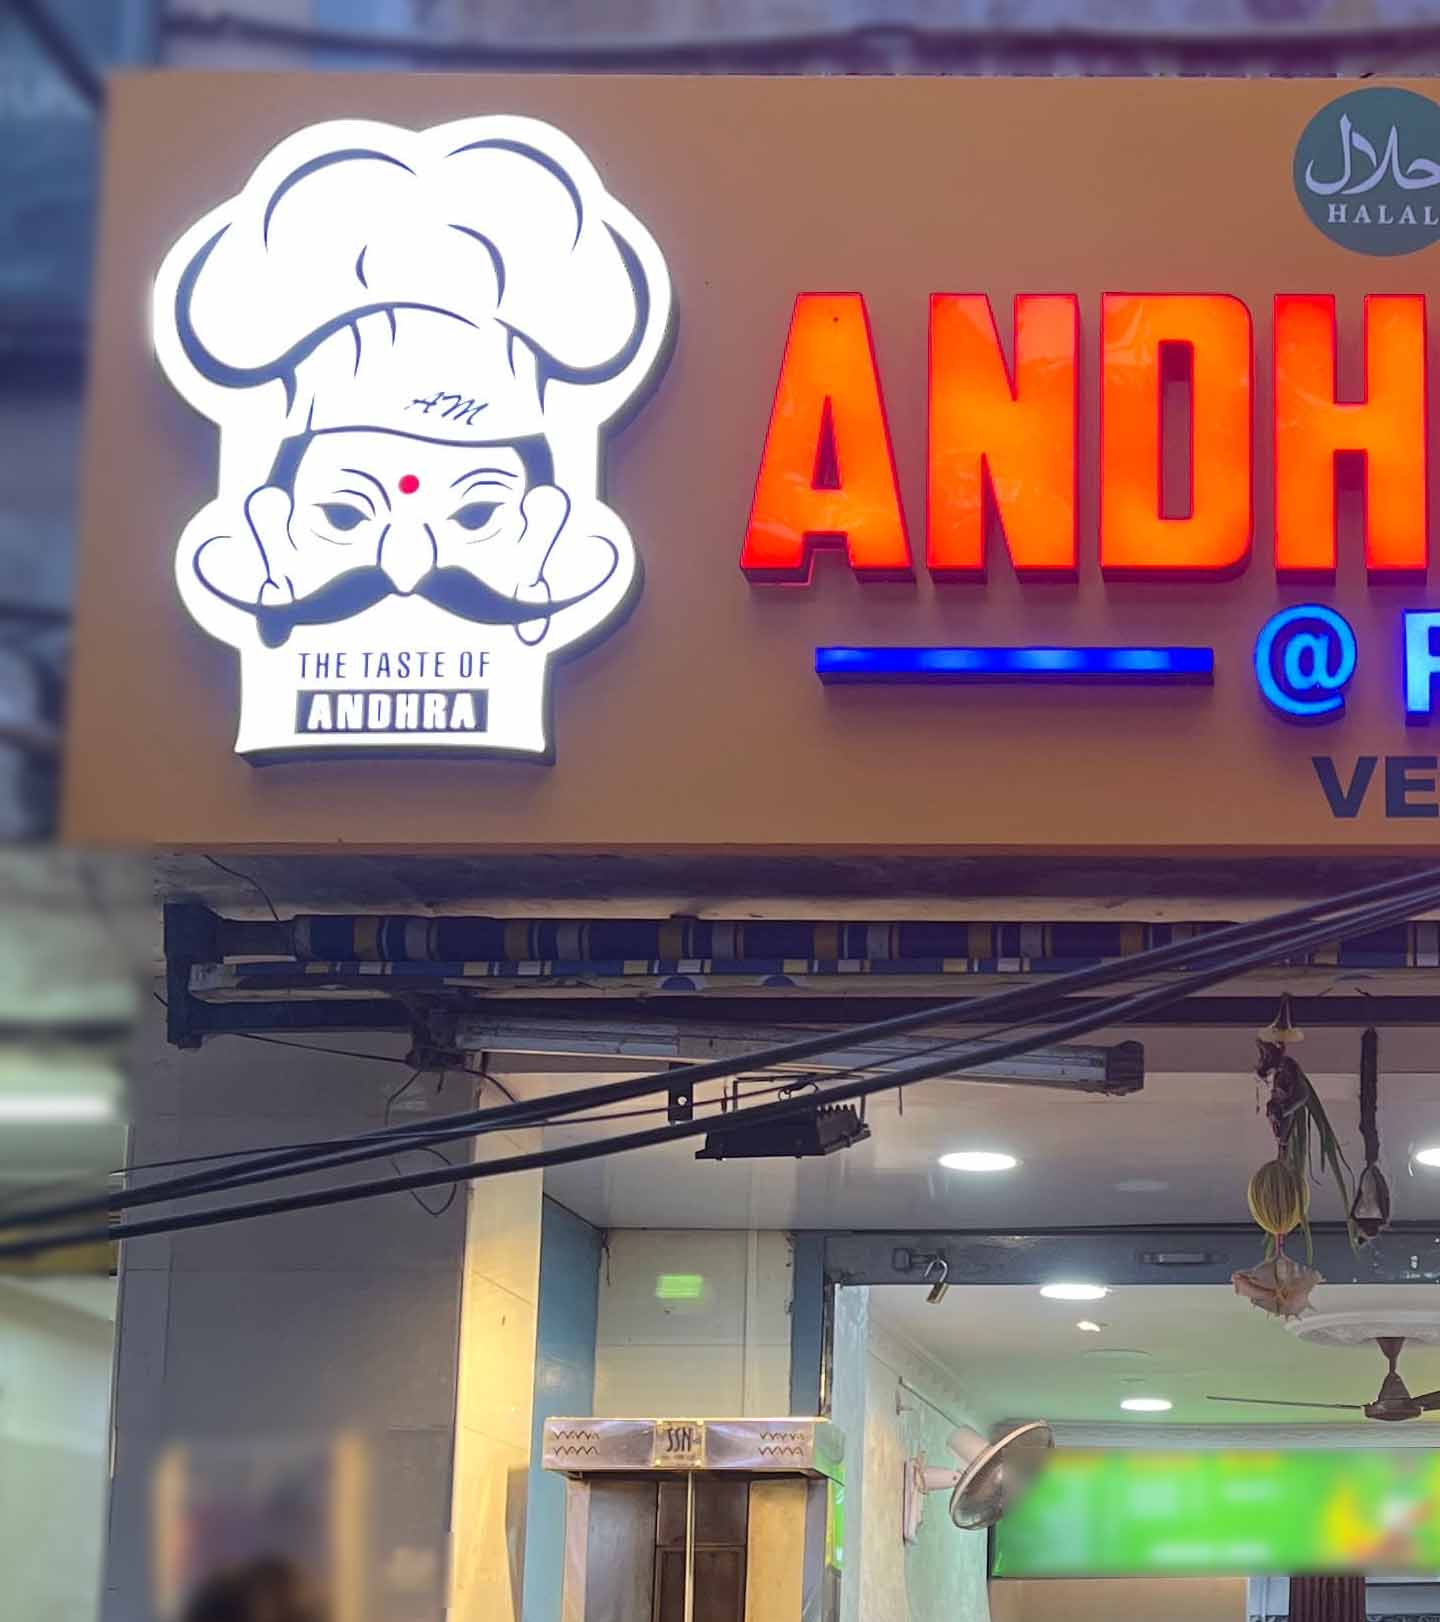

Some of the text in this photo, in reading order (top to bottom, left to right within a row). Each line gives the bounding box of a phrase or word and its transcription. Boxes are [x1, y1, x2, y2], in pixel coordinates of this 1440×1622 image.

[1326, 202, 1440, 227] HALAL
[298, 650, 491, 680] THE TASTE OF
[1254, 603, 1357, 720] @
[306, 691, 477, 731] ANDHRA
